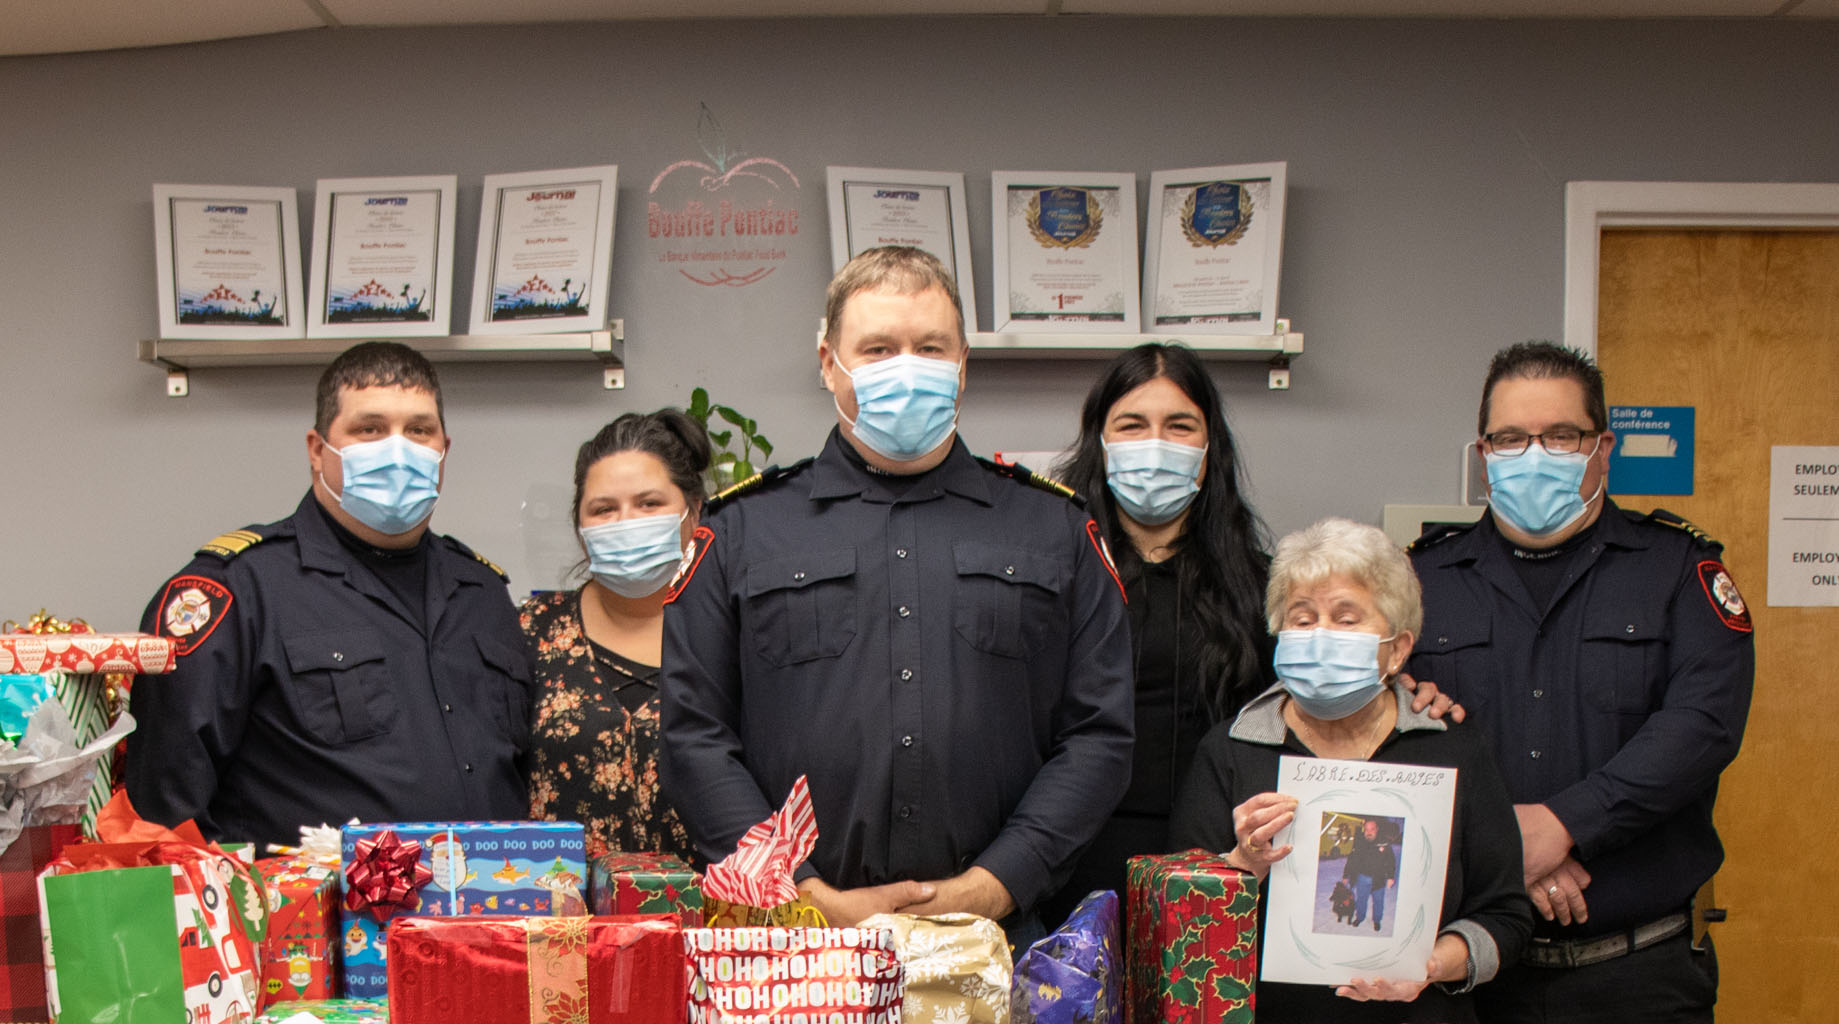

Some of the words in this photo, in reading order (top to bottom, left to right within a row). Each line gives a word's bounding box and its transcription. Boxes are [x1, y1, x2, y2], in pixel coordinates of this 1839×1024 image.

[648, 201, 714, 238] Bouffe
[720, 200, 799, 237] Pontiac
[1611, 408, 1637, 418] Salle
[1640, 408, 1653, 418] de
[1611, 420, 1670, 430] conférence
[1795, 464, 1839, 475] EMPLO
[1812, 575, 1839, 586] ONL
[475, 840, 498, 851] DOO
[504, 839, 526, 850] DOO
[532, 838, 555, 850] DOO
[561, 838, 583, 850] DOO
[346, 974, 366, 986] OO
[371, 974, 387, 986] DO
